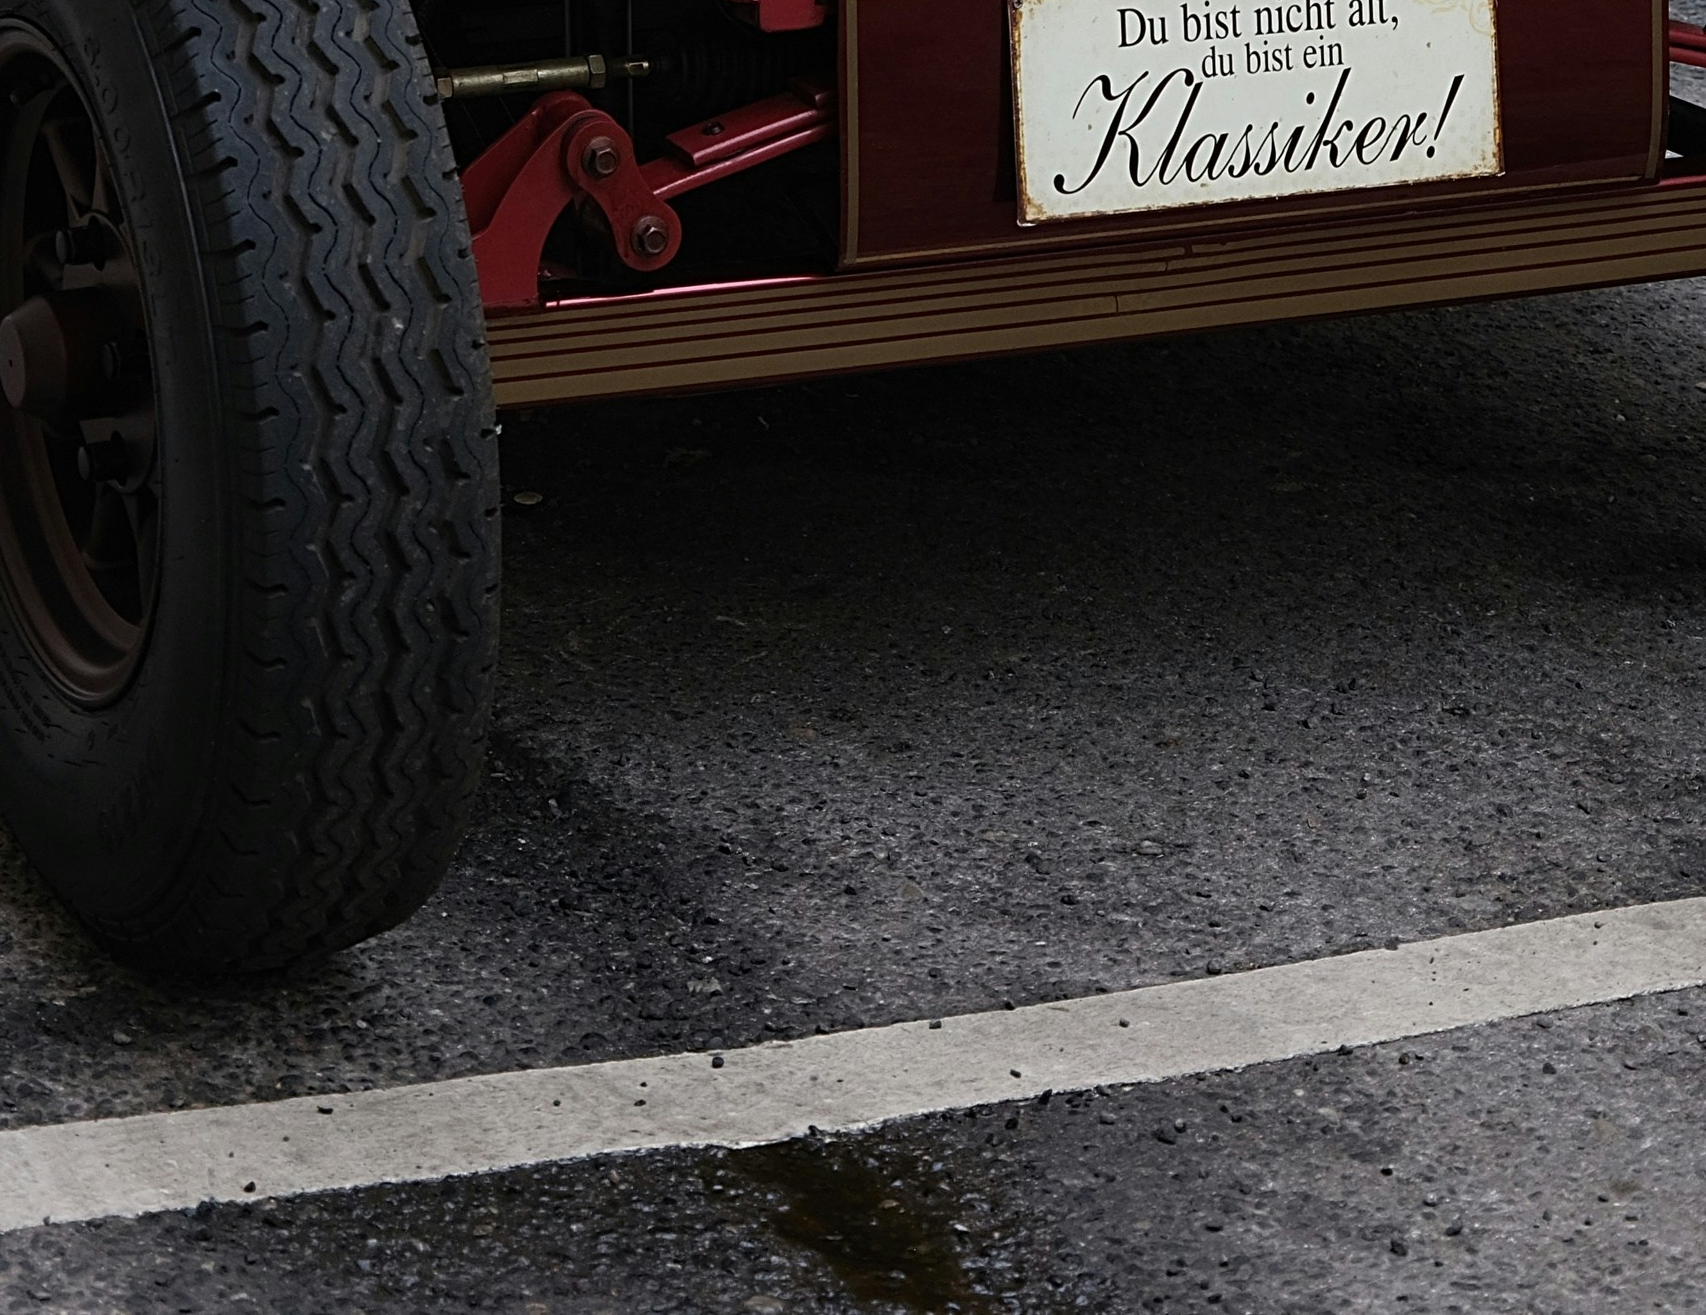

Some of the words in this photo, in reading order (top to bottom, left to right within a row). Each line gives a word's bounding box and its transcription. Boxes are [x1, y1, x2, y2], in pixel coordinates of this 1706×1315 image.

[1116, 6, 1169, 48] Du
[1181, 0, 1242, 42] bist
[1201, 46, 1235, 78] du
[1244, 39, 1293, 74] bist
[1303, 35, 1345, 68] ein
[1054, 68, 1466, 196] Klassiker!
